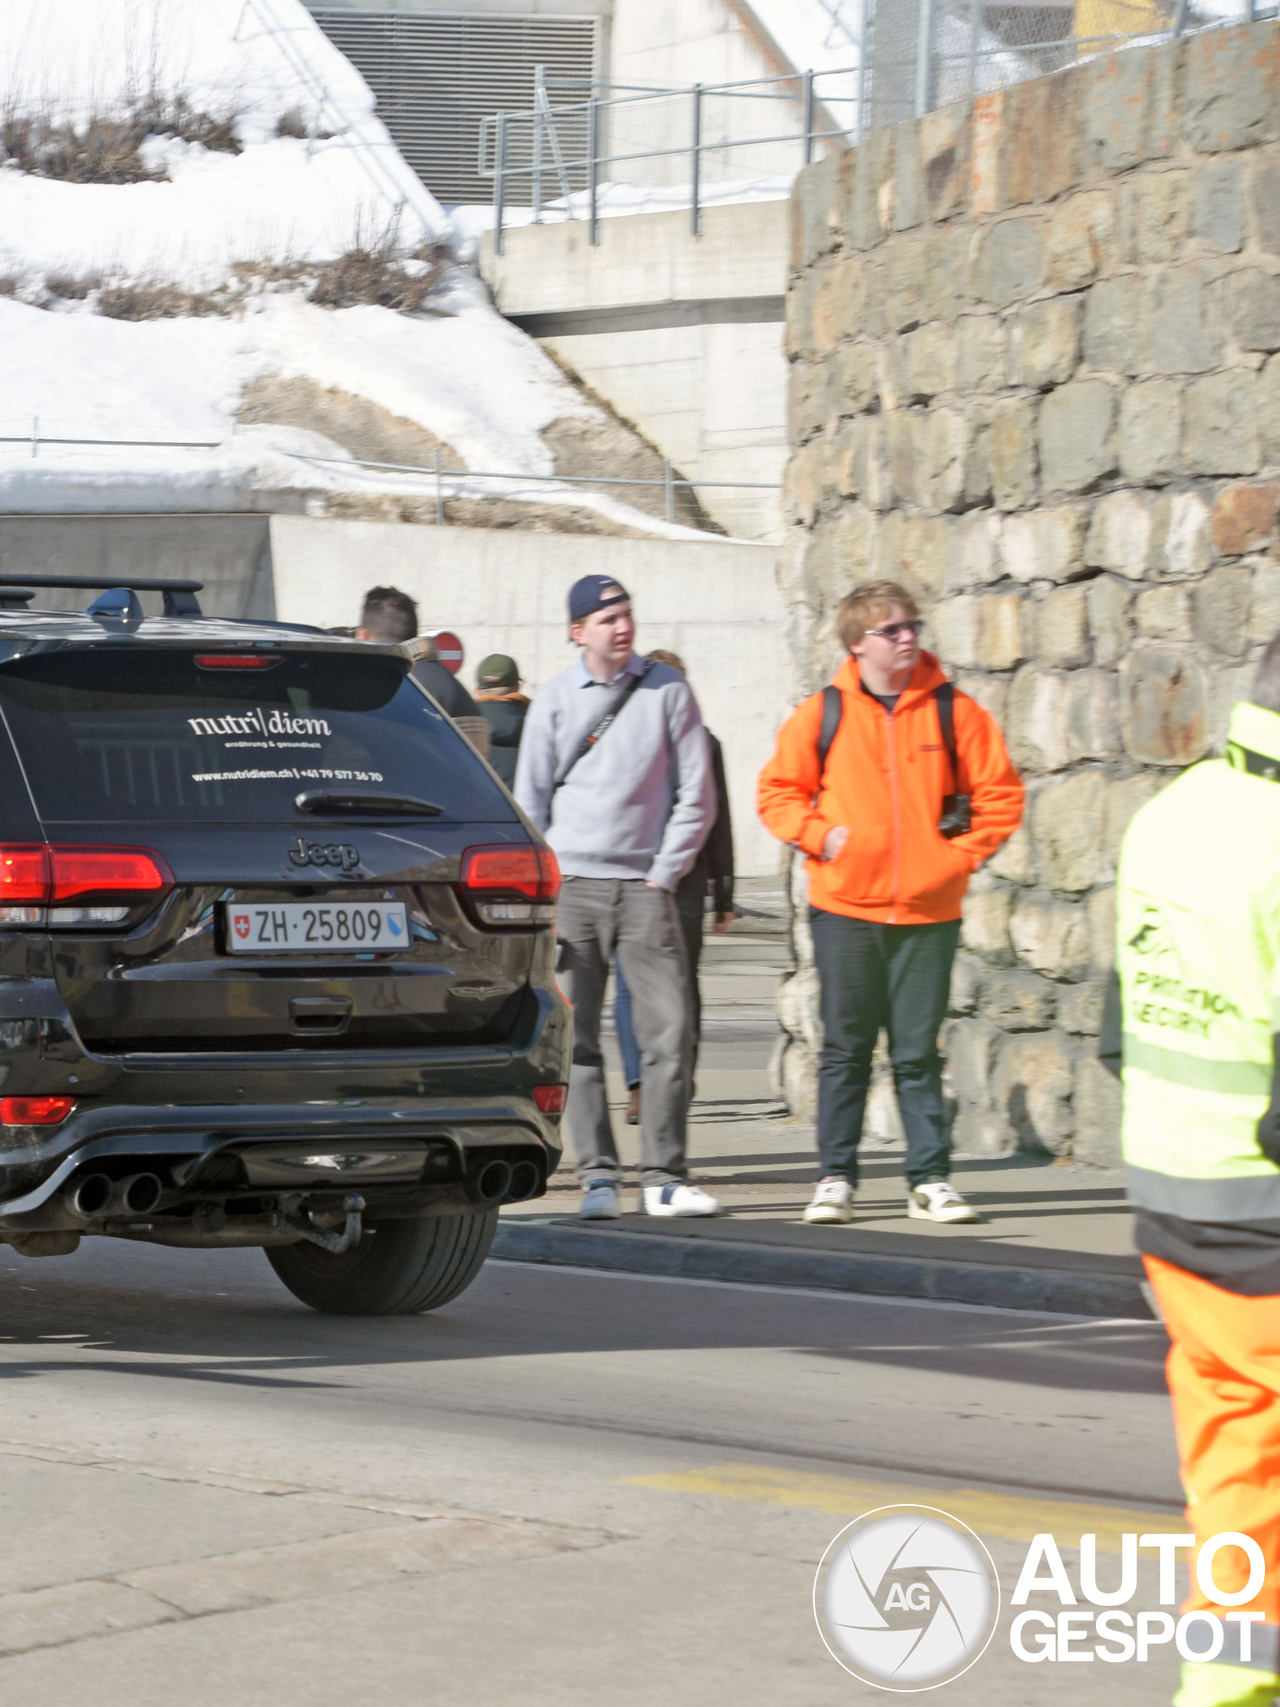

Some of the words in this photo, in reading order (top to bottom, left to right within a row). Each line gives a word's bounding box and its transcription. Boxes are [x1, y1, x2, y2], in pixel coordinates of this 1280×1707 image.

[192, 768, 293, 782] www.nutridiem.ch
[300, 769, 319, 779] +41
[319, 769, 333, 779] 79
[334, 769, 353, 780] 577
[355, 770, 369, 781] 36
[368, 771, 384, 782] 70
[288, 837, 360, 872] Jeep
